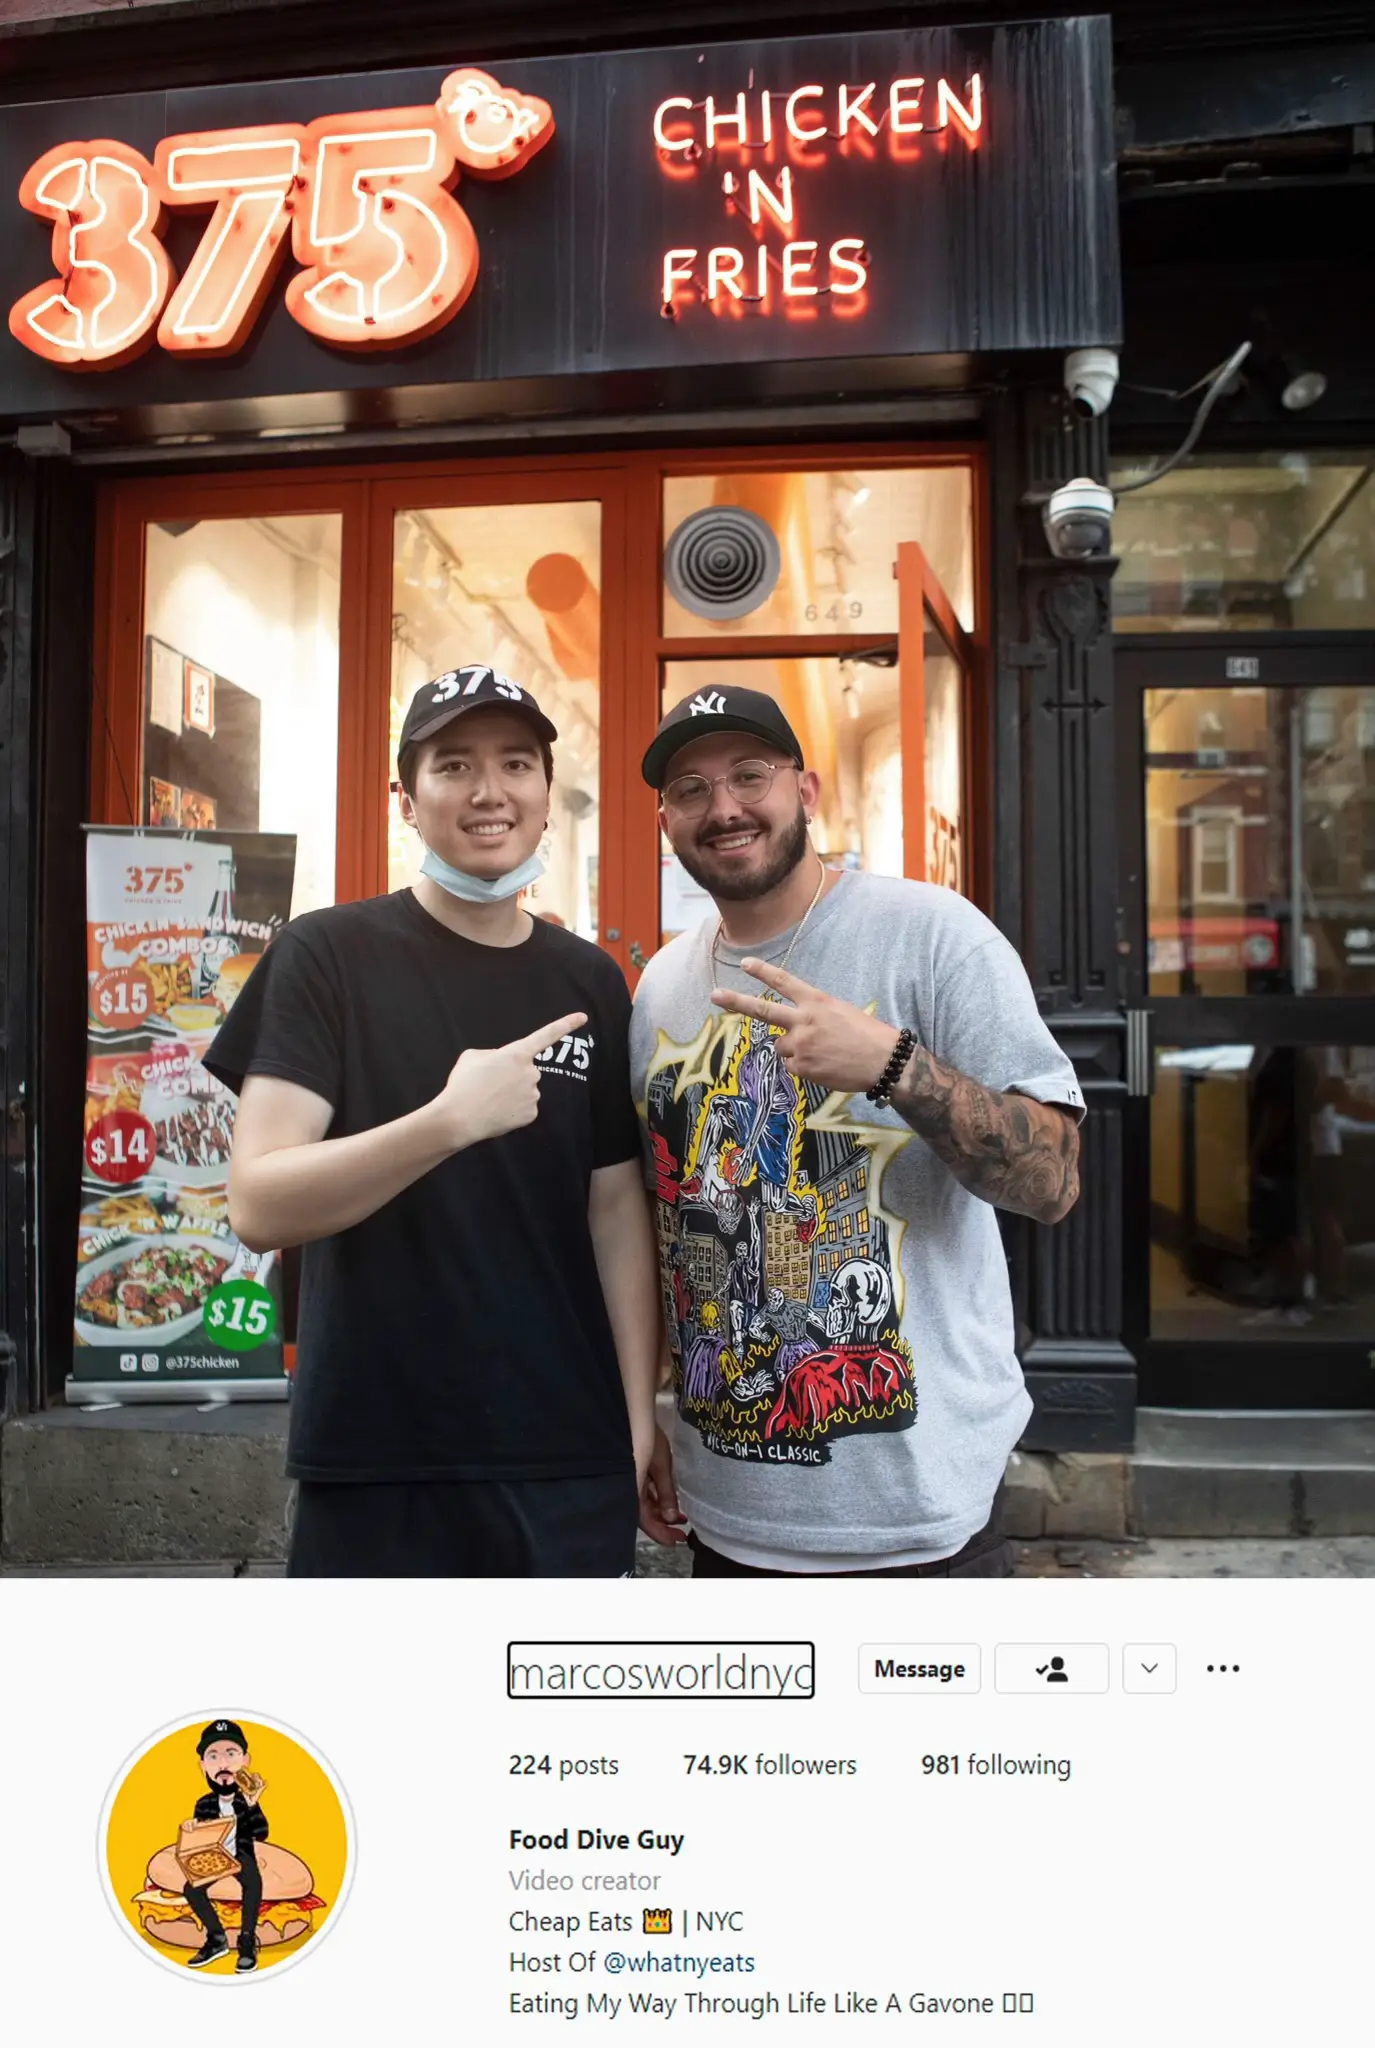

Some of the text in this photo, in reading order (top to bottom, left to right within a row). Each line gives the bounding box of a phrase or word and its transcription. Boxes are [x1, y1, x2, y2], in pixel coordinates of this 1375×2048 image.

[652, 74, 984, 152] CHICKEN
[722, 167, 794, 225] 'N
[9, 106, 479, 371] 375
[662, 238, 867, 304] FRIES
[804, 601, 863, 622] 649
[431, 666, 523, 703] 375
[124, 865, 184, 894] 375
[99, 982, 148, 1017] $15
[571, 1072, 587, 1081] FRIES
[91, 1128, 149, 1166] $14
[82, 1222, 131, 1256] CHICK
[161, 1213, 230, 1238] WAFFLE
[208, 1296, 271, 1335] $15
[166, 1356, 240, 1370] @375chicken
[768, 1443, 821, 1463] CLASSIC
